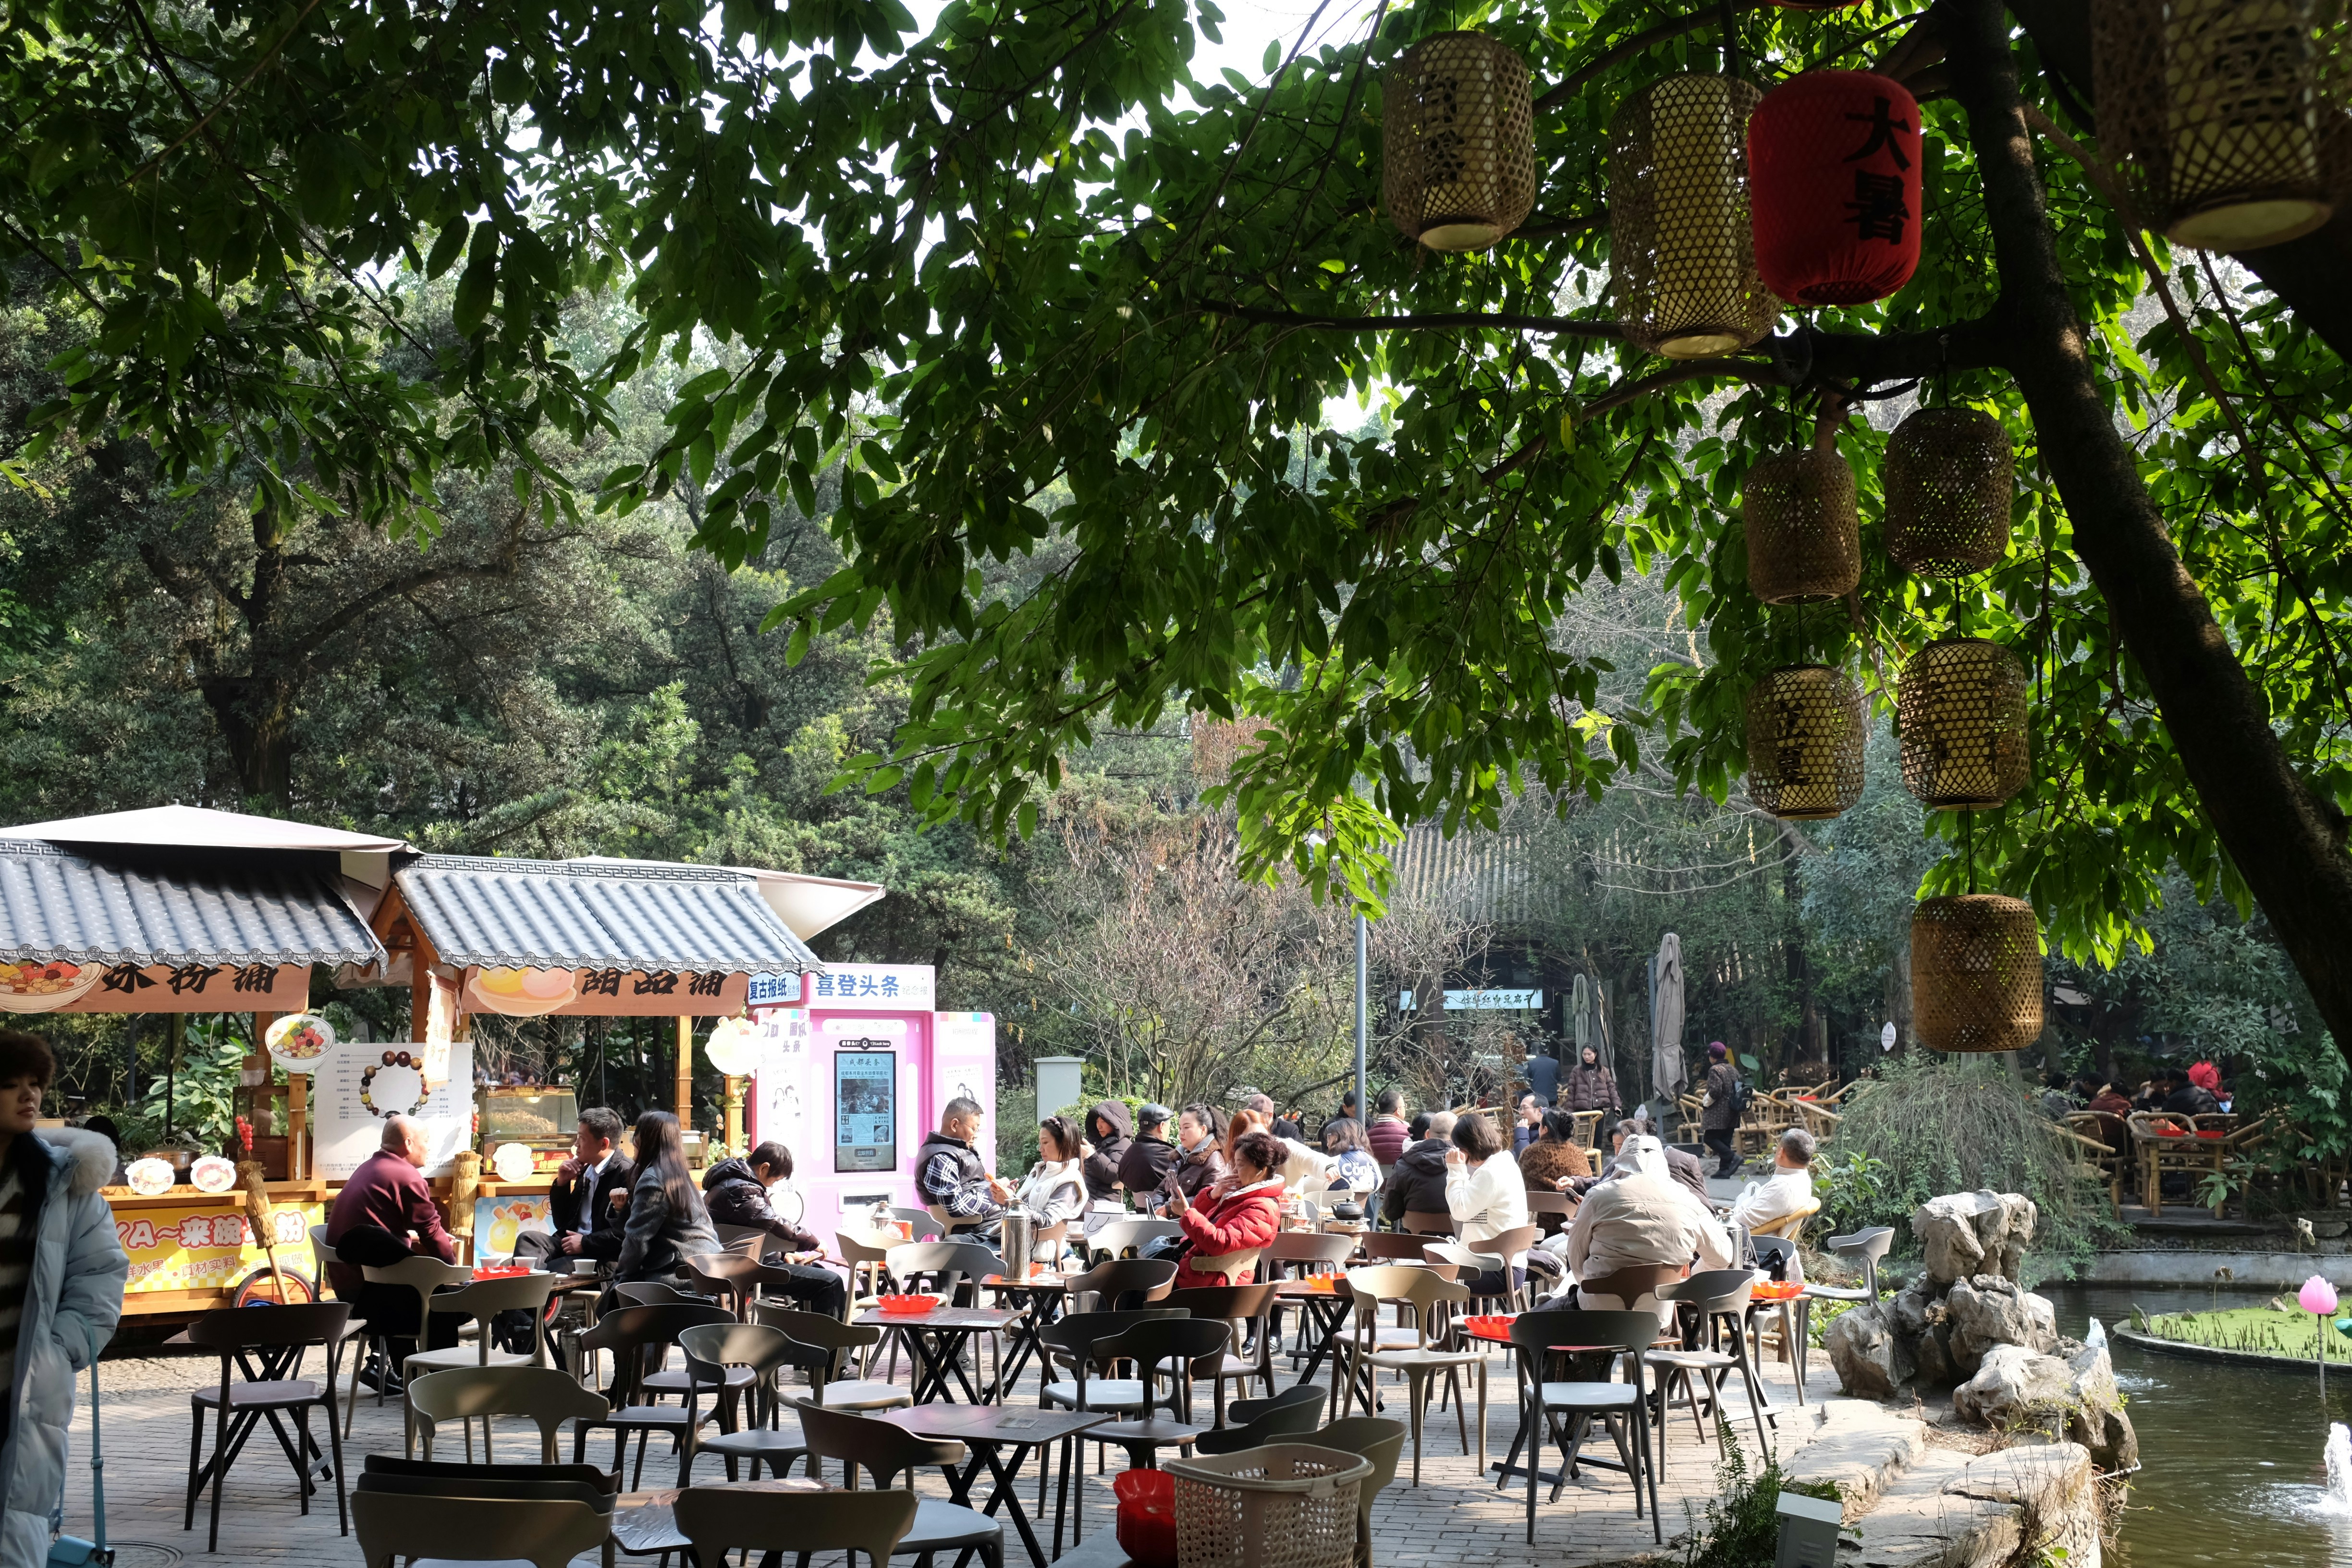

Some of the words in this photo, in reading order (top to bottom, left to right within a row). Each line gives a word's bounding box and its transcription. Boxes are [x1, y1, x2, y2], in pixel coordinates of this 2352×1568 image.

[1842, 97, 1911, 245] 大暑
[749, 977, 787, 1000] 复古报纸
[816, 974, 899, 998] 喜登头条
[902, 985, 928, 995] 纪念报
[849, 1058, 880, 1066] 成都头条
[181, 1256, 236, 1278] 真材实料
